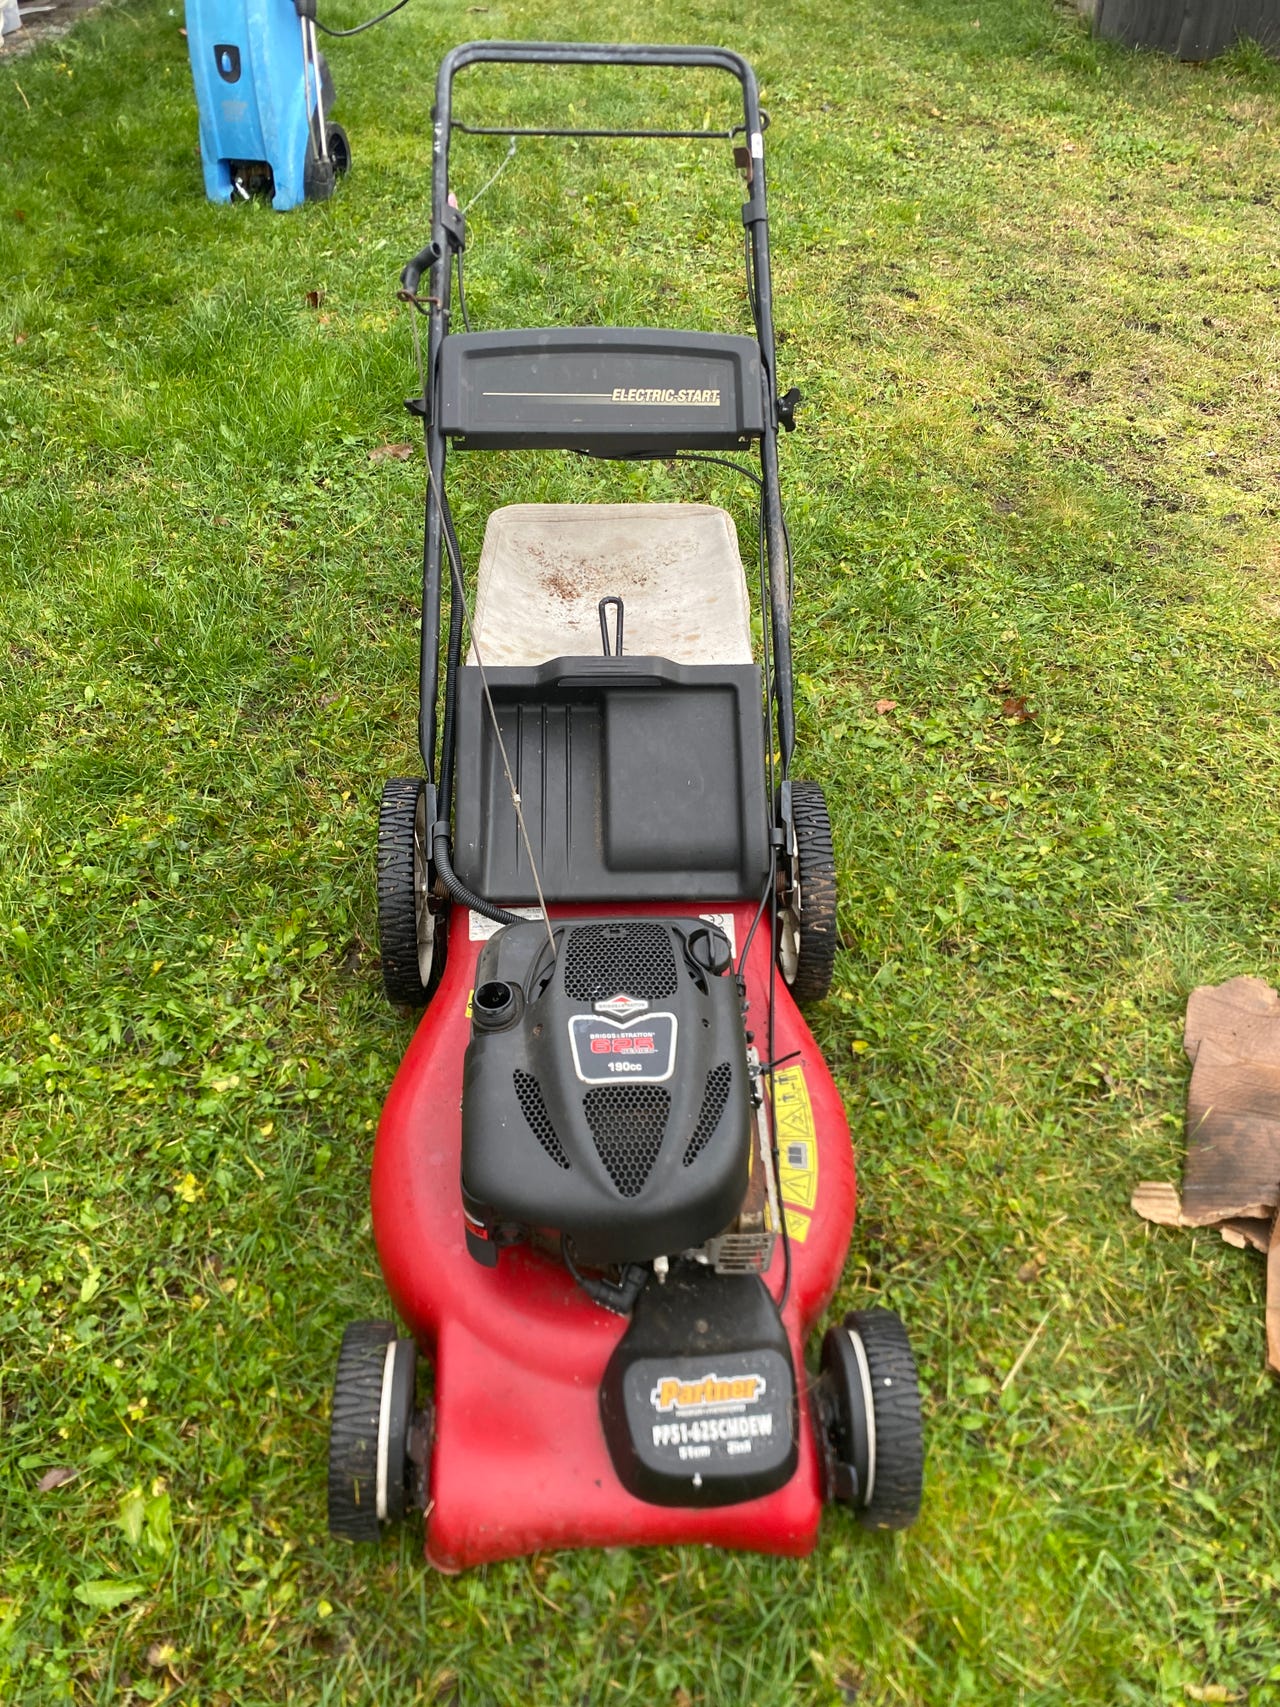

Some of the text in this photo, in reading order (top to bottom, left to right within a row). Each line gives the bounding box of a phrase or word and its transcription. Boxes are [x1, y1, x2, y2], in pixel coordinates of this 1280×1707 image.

[591, 1037, 655, 1054] 625
[608, 1062, 642, 1071] 190cc
[658, 1375, 759, 1410] Partner
